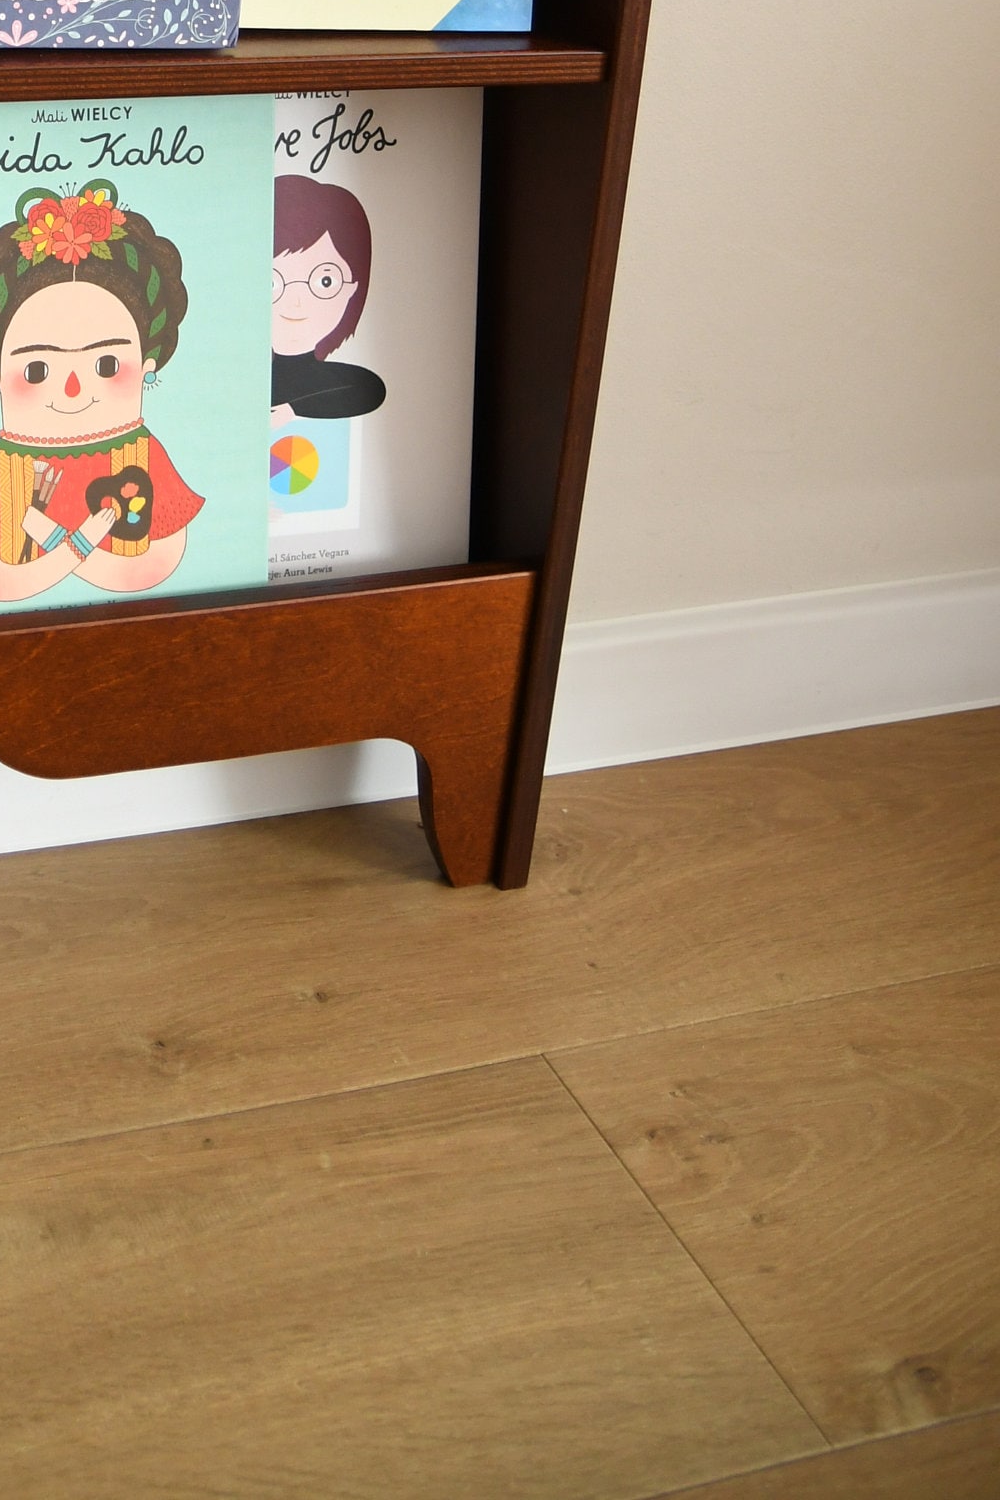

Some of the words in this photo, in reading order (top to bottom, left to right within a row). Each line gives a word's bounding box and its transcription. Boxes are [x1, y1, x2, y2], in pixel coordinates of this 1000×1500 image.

[31, 108, 68, 123] Mali
[71, 106, 133, 121] WIELCY
[310, 103, 397, 173] Jobs
[80, 125, 205, 170] Kahlo
[280, 550, 317, 563] Sánchez
[319, 549, 350, 560] Vegara
[284, 568, 306, 577] Aura
[308, 565, 333, 576] Lewis
